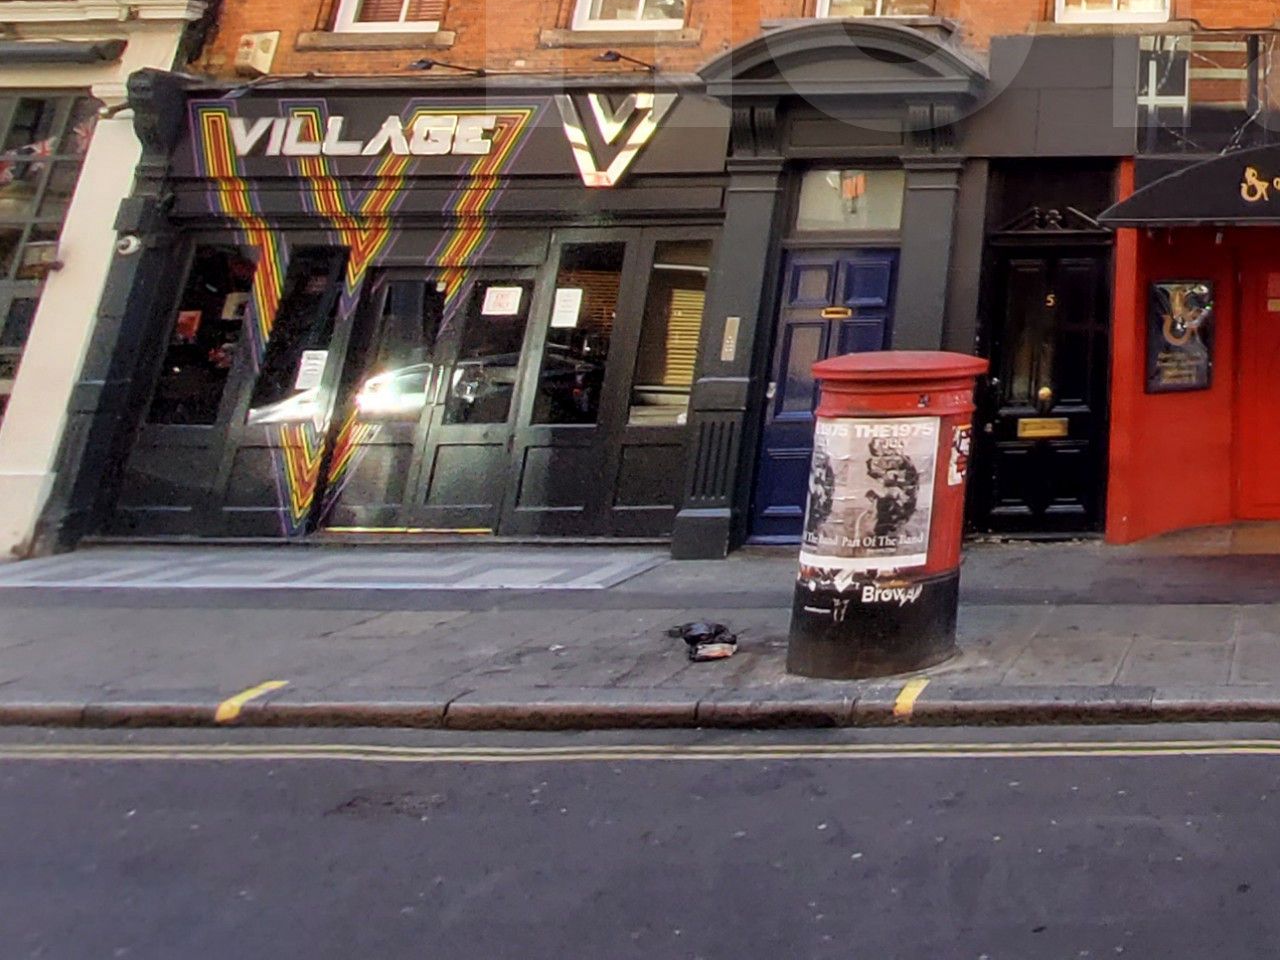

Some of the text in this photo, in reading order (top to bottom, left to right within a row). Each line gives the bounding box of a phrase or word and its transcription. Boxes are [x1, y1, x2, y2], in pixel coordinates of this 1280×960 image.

[227, 114, 497, 157] VILLAGE
[1045, 293, 1056, 307] 5
[863, 535, 876, 547] Of
[879, 536, 896, 547] The
